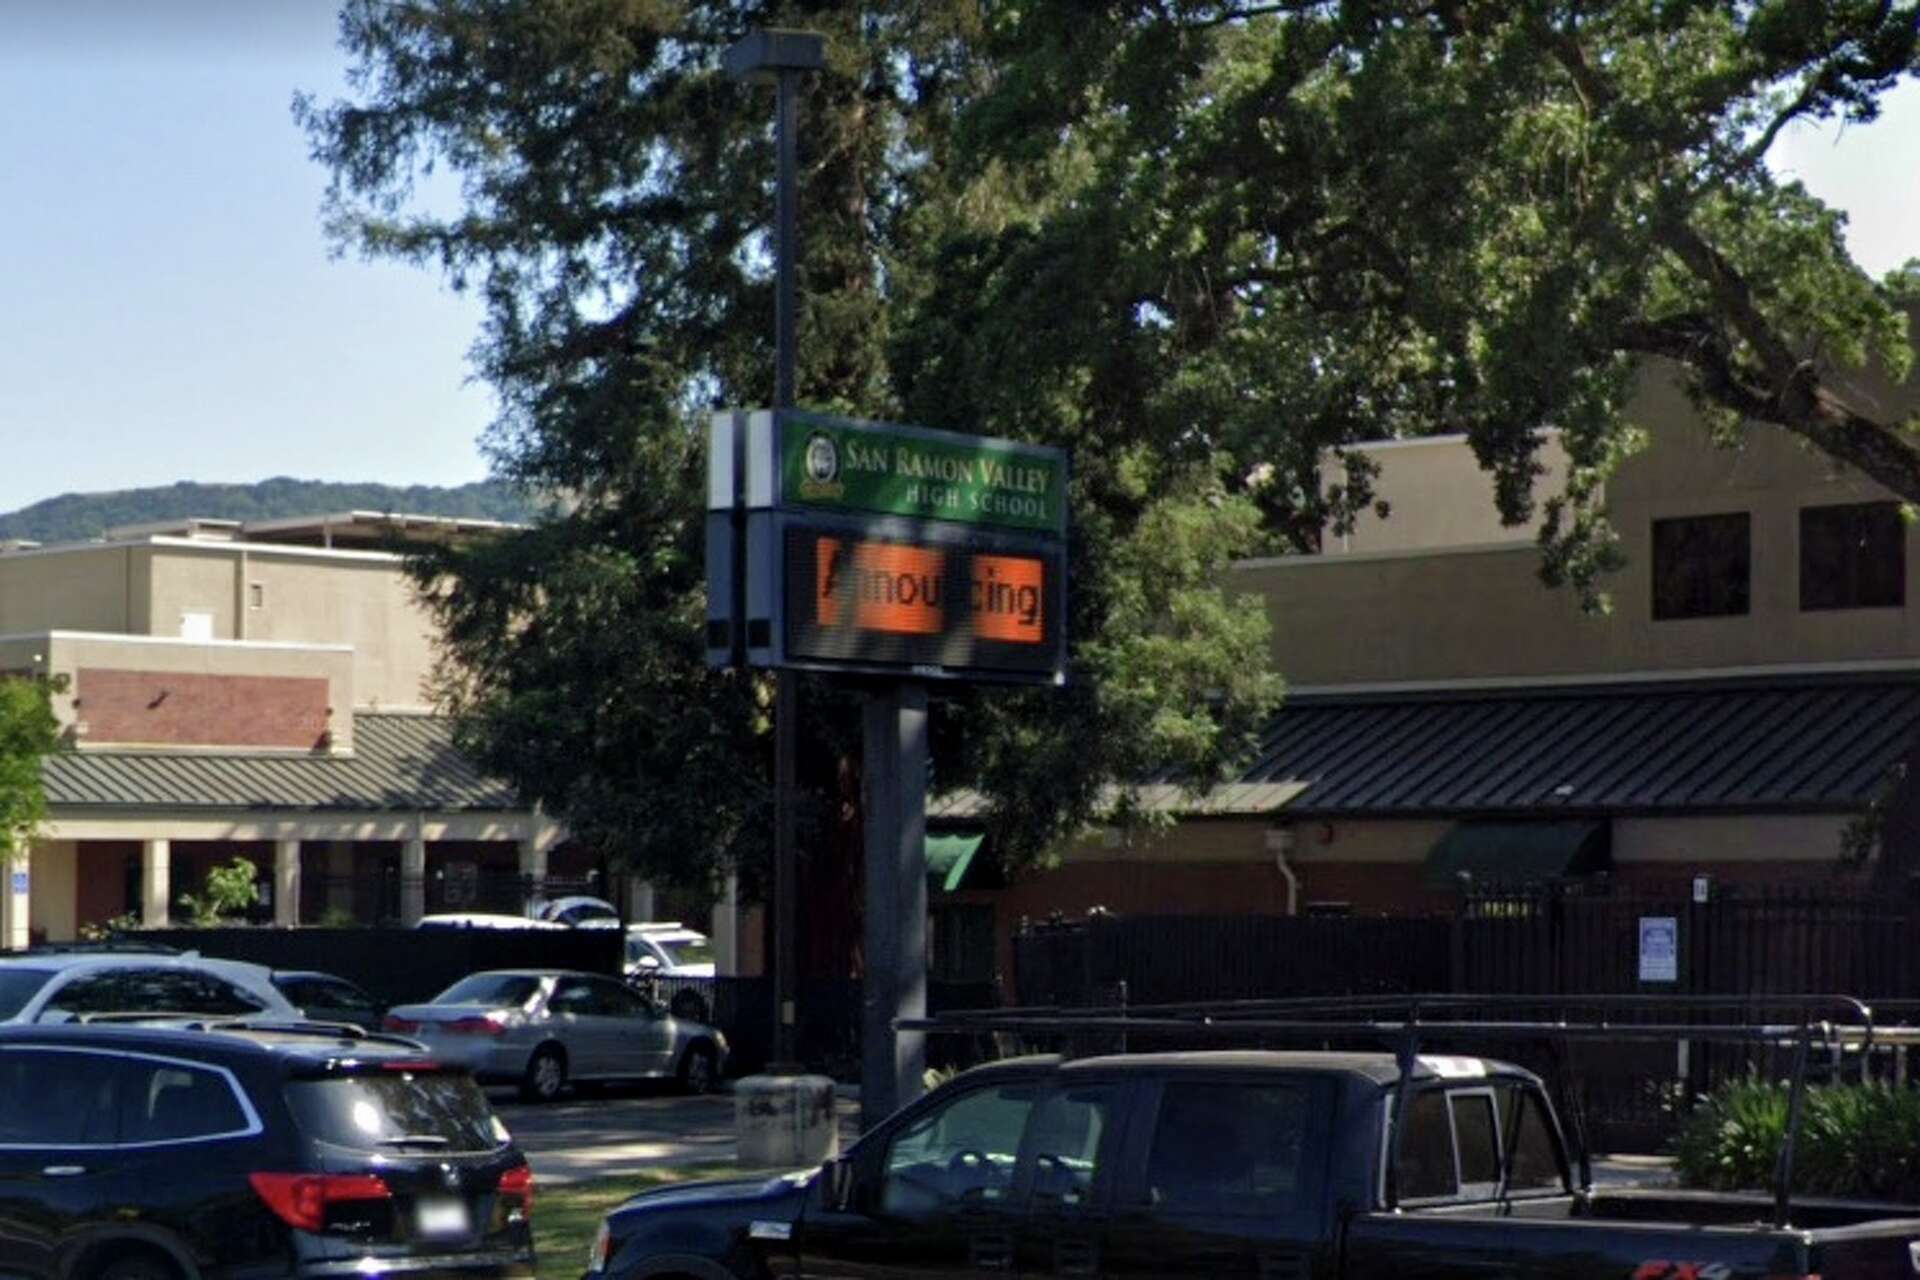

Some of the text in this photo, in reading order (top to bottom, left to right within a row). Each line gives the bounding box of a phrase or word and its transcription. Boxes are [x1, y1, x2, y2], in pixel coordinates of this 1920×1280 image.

[846, 438, 1050, 494] SAN RAMON VALLEY
[906, 484, 1047, 519] HIGH SCHOOL
